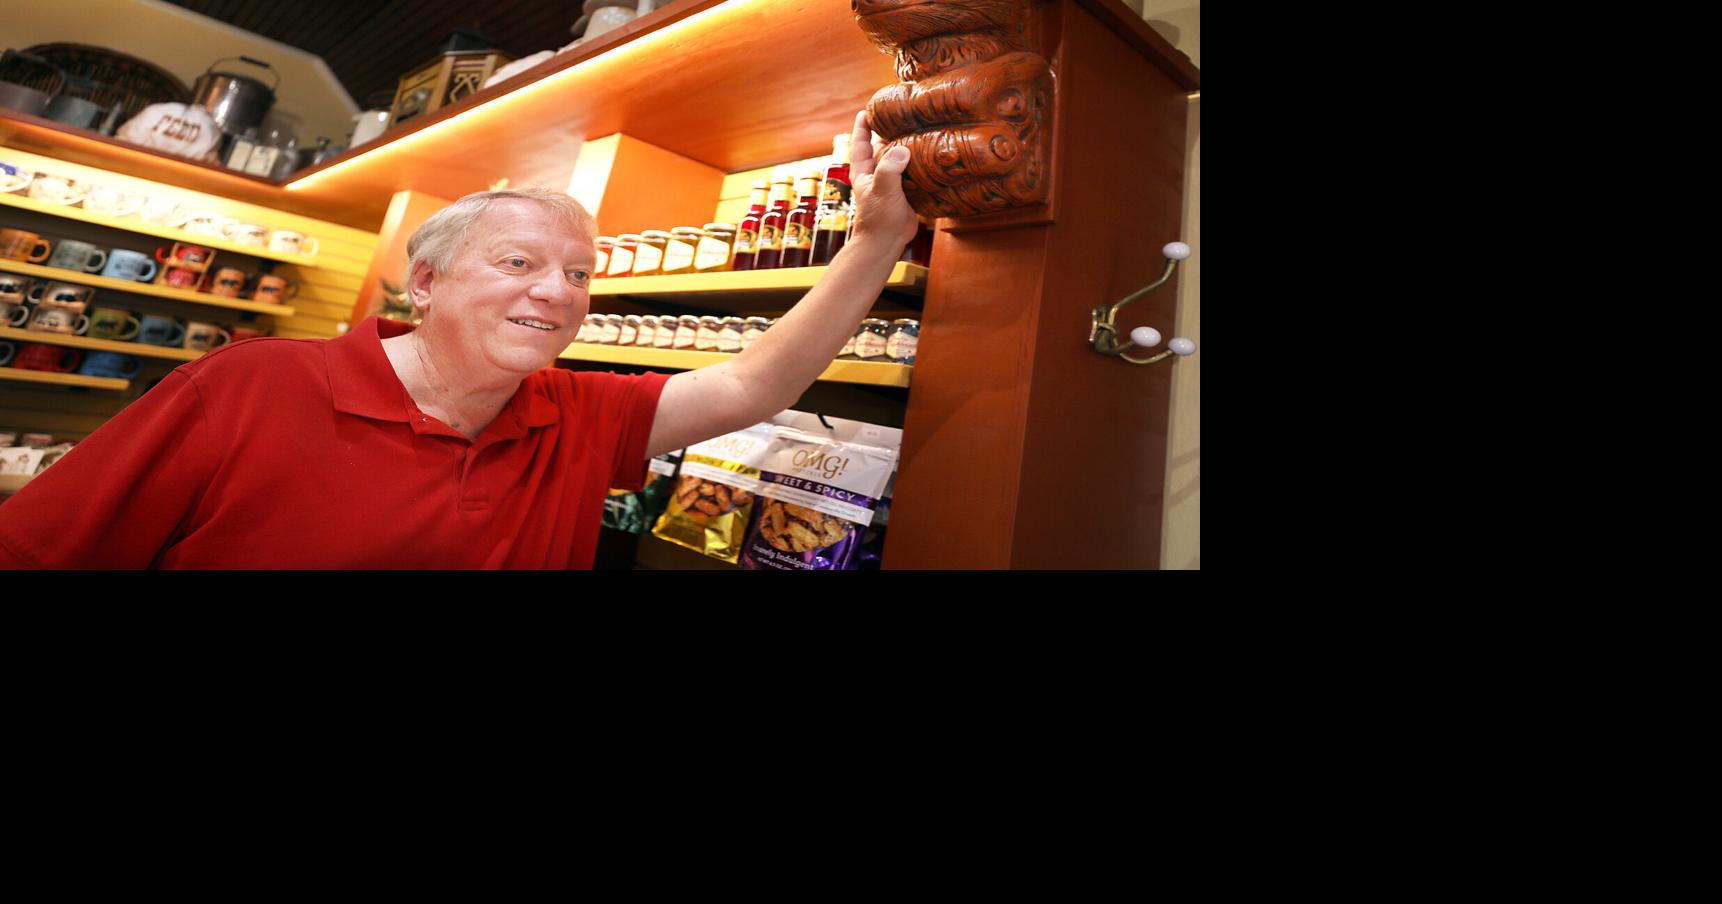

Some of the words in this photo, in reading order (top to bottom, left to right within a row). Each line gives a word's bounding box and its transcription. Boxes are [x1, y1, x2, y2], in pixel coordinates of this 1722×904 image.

[792, 449, 850, 480] OMG!
[767, 472, 802, 487] WEET
[803, 481, 813, 490] &
[815, 484, 856, 501] SPICY
